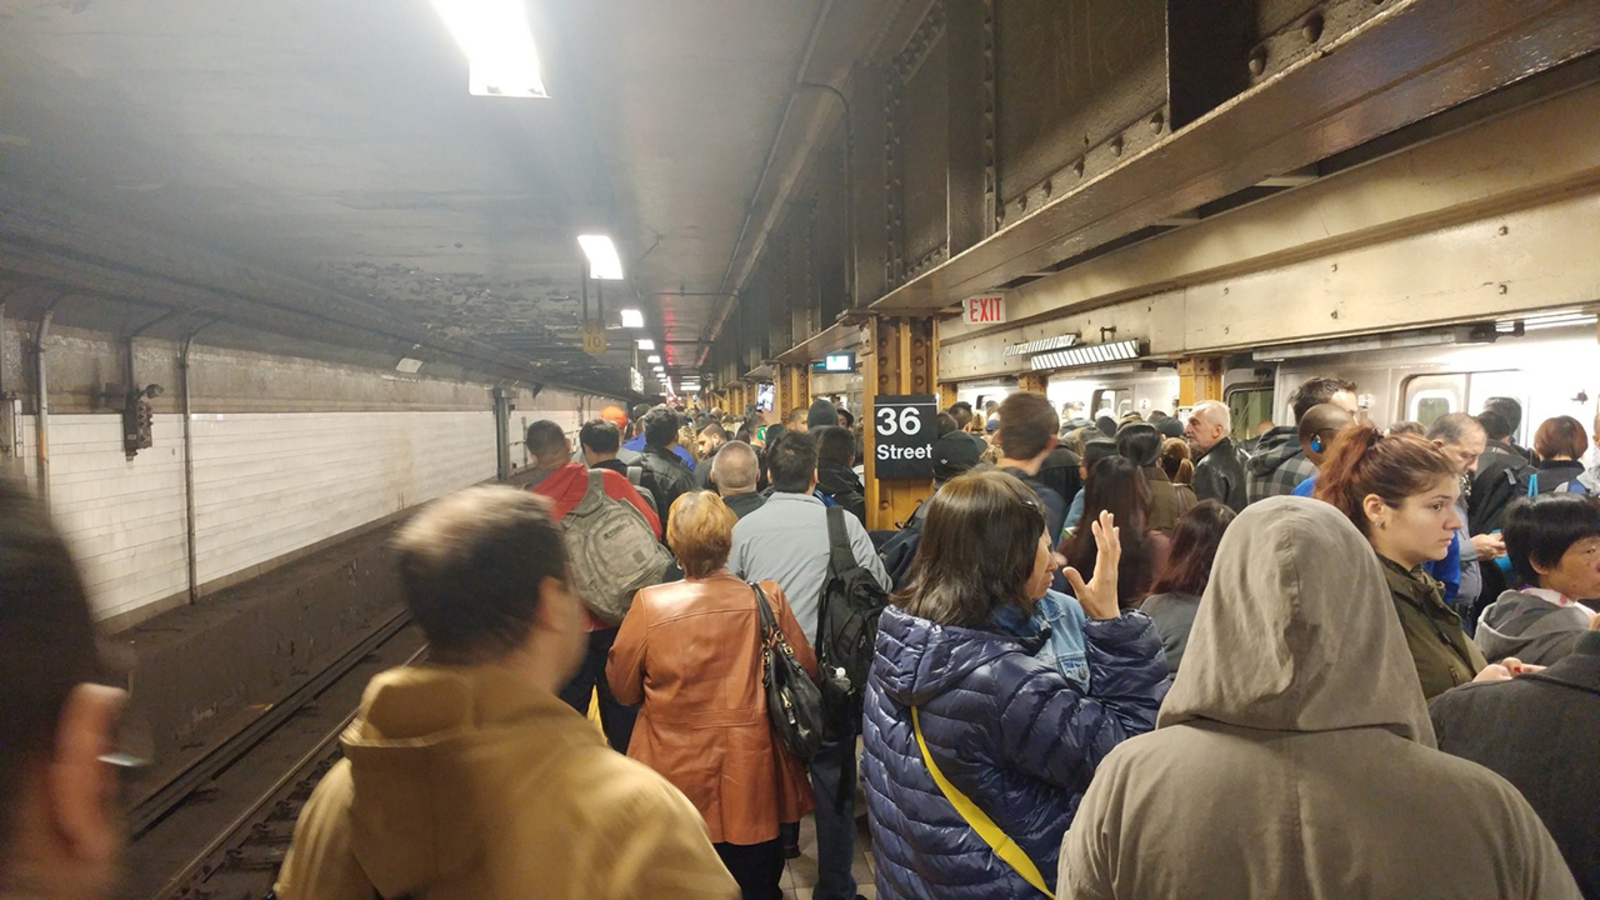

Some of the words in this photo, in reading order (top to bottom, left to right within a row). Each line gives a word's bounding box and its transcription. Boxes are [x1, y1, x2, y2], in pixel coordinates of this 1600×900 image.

[969, 297, 1002, 322] EXIT
[876, 407, 921, 436] 36
[877, 443, 933, 460] Street
